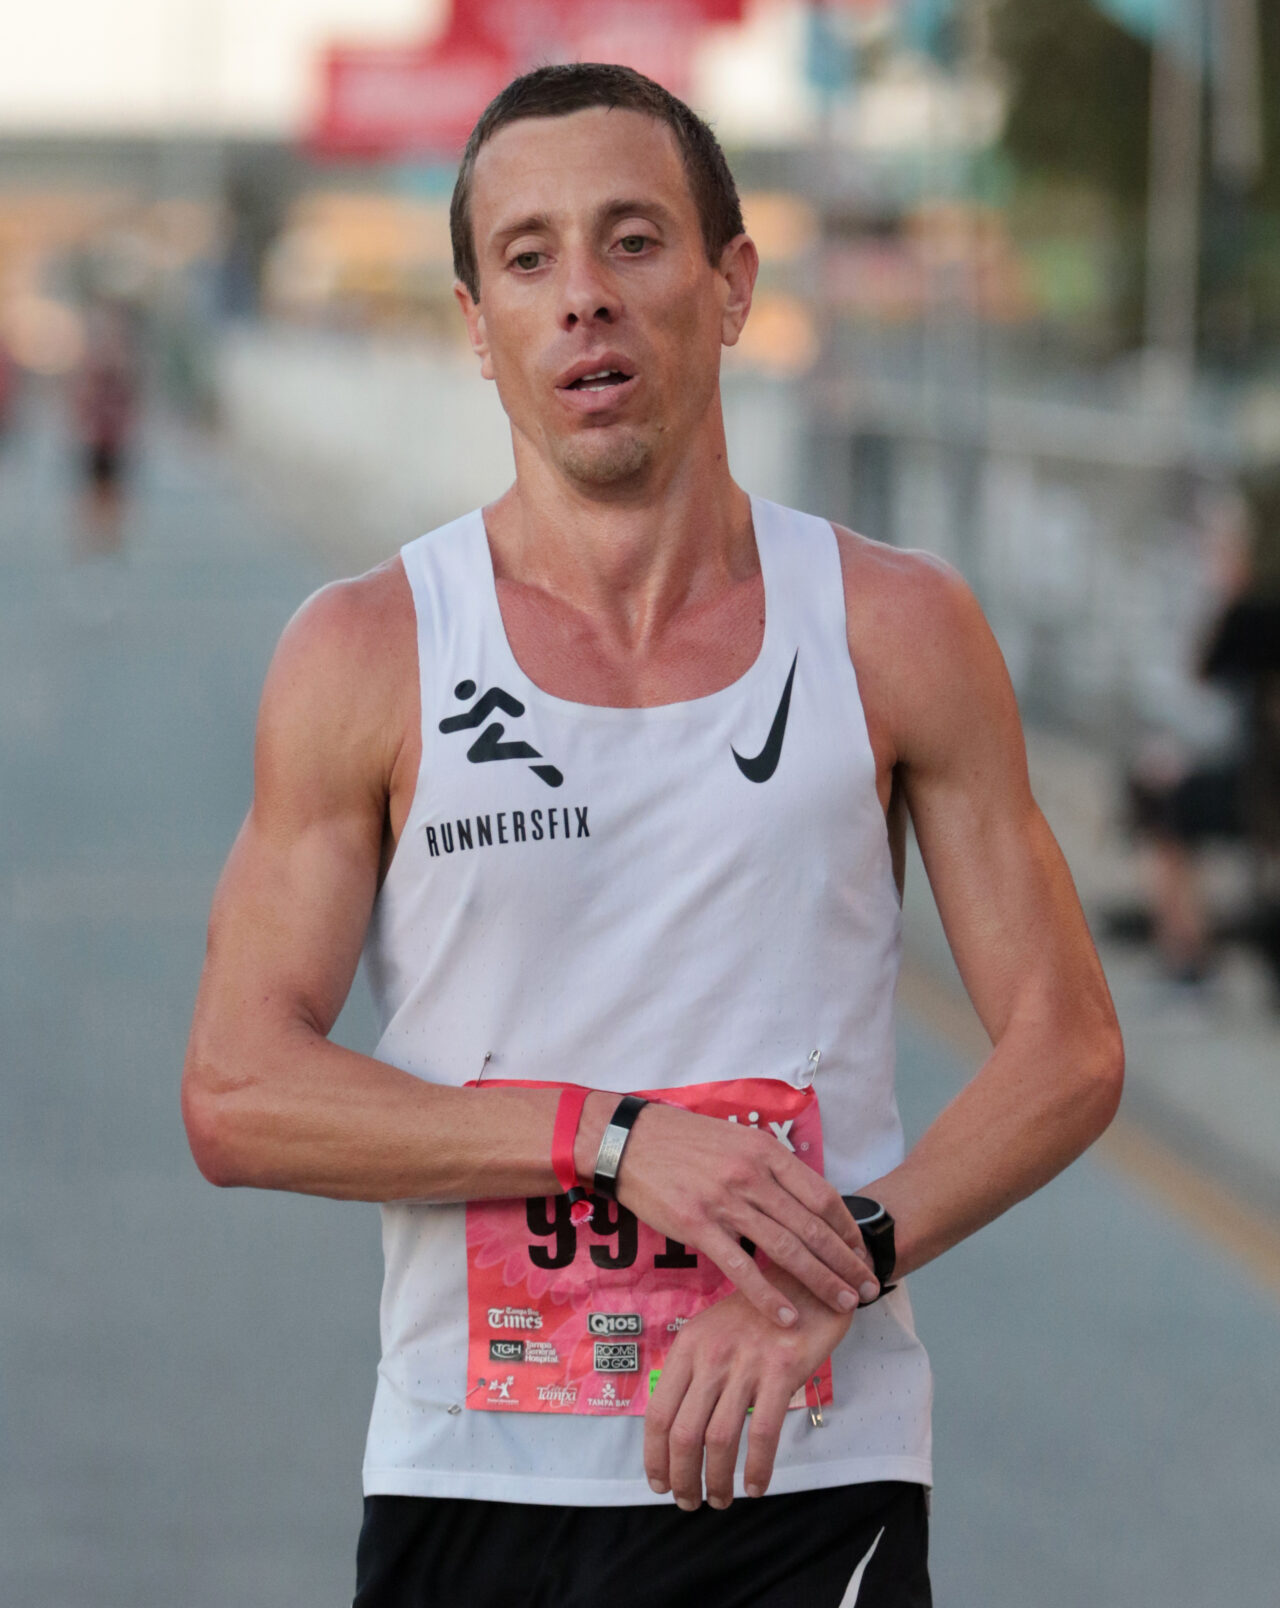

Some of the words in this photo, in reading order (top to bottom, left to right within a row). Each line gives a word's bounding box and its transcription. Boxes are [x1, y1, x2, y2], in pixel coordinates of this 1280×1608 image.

[426, 806, 591, 857] RUNNERSFIX
[487, 1307, 543, 1329] Times
[591, 1314, 637, 1334] Q105
[495, 1343, 522, 1355] TGH
[525, 1340, 553, 1351] Tampa
[596, 1345, 635, 1356] ROOMS
[525, 1348, 556, 1356] General
[597, 1359, 611, 1369] TO
[611, 1358, 630, 1369] GO
[536, 1386, 578, 1407] Tampa
[587, 1397, 614, 1407] TAMPA
[615, 1398, 631, 1407] BAY
